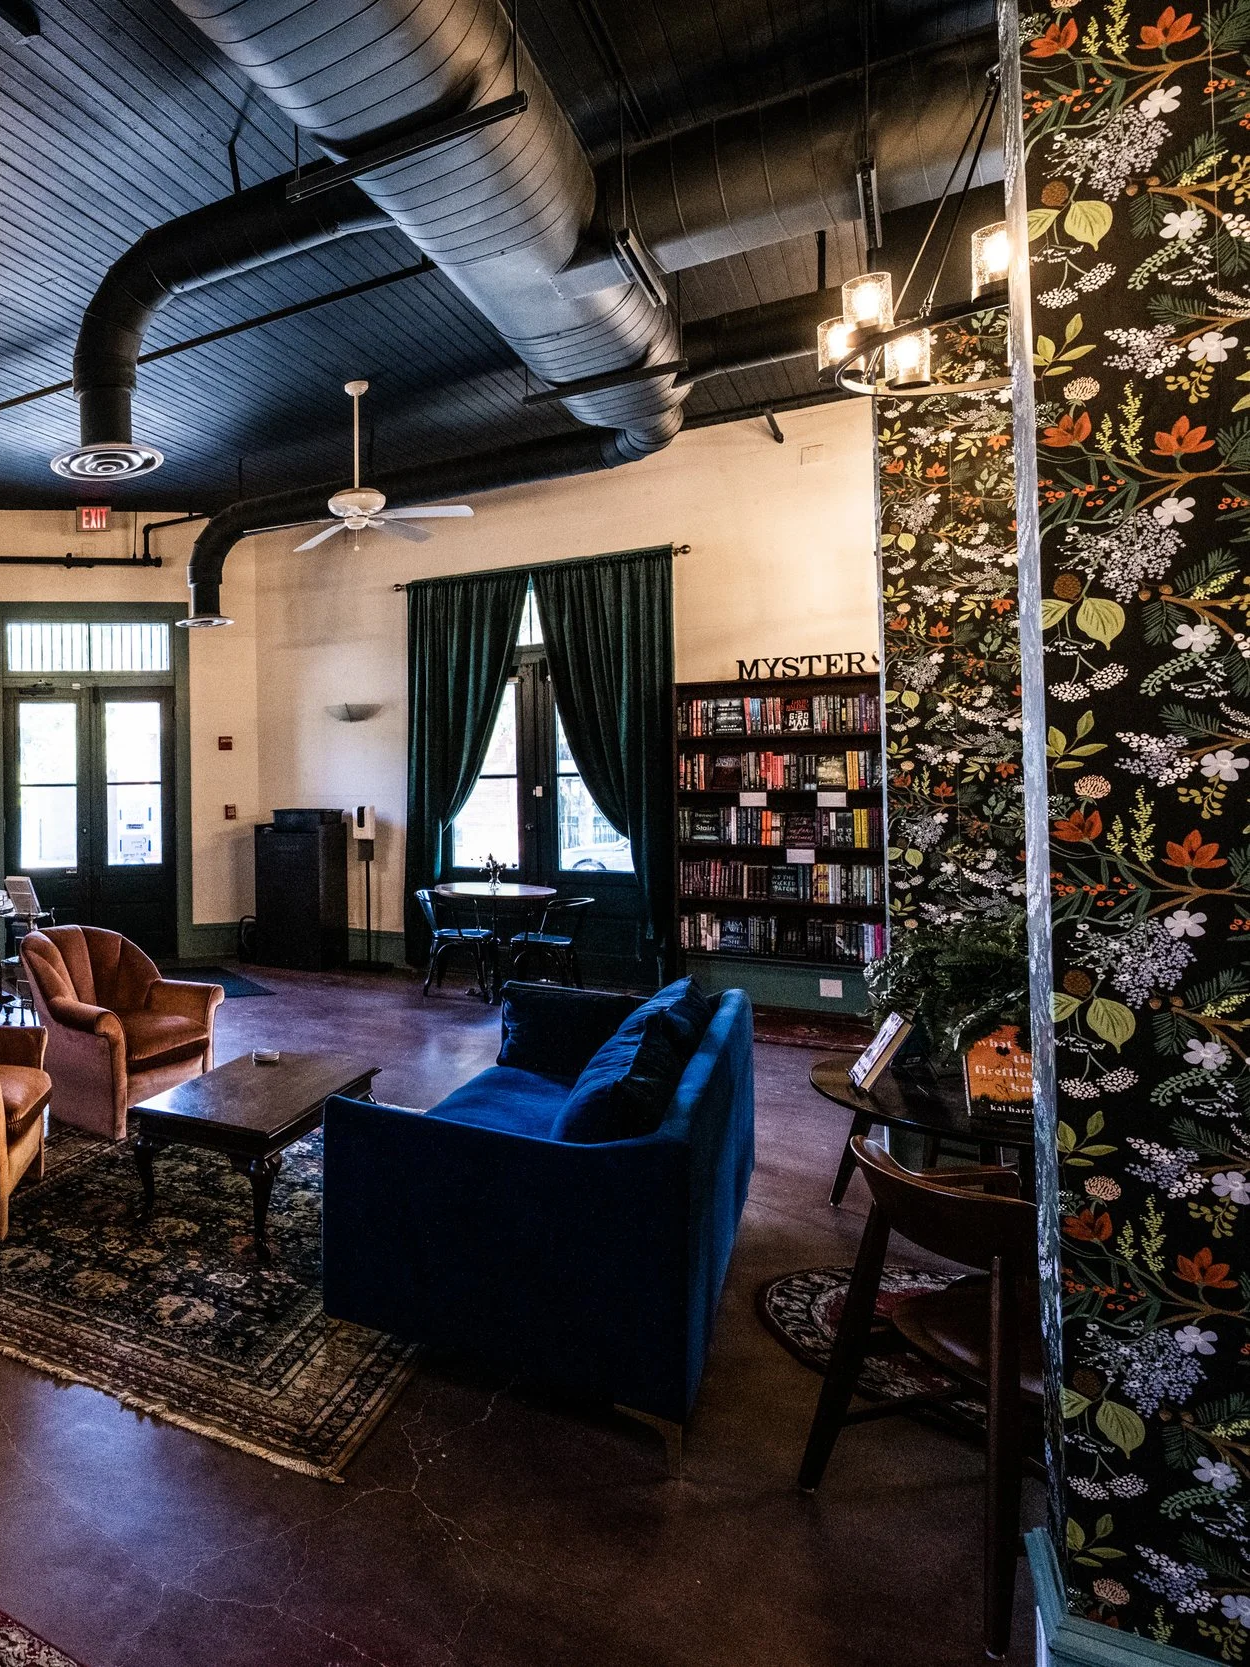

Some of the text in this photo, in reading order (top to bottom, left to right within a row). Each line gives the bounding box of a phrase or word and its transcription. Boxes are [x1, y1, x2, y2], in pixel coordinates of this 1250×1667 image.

[82, 508, 107, 528] EXIT
[789, 719, 809, 727] MAN
[977, 1038, 1013, 1049] what
[1013, 1055, 1033, 1064] th
[975, 1064, 1033, 1079] fireflies
[990, 1104, 1035, 1115] kai harri
